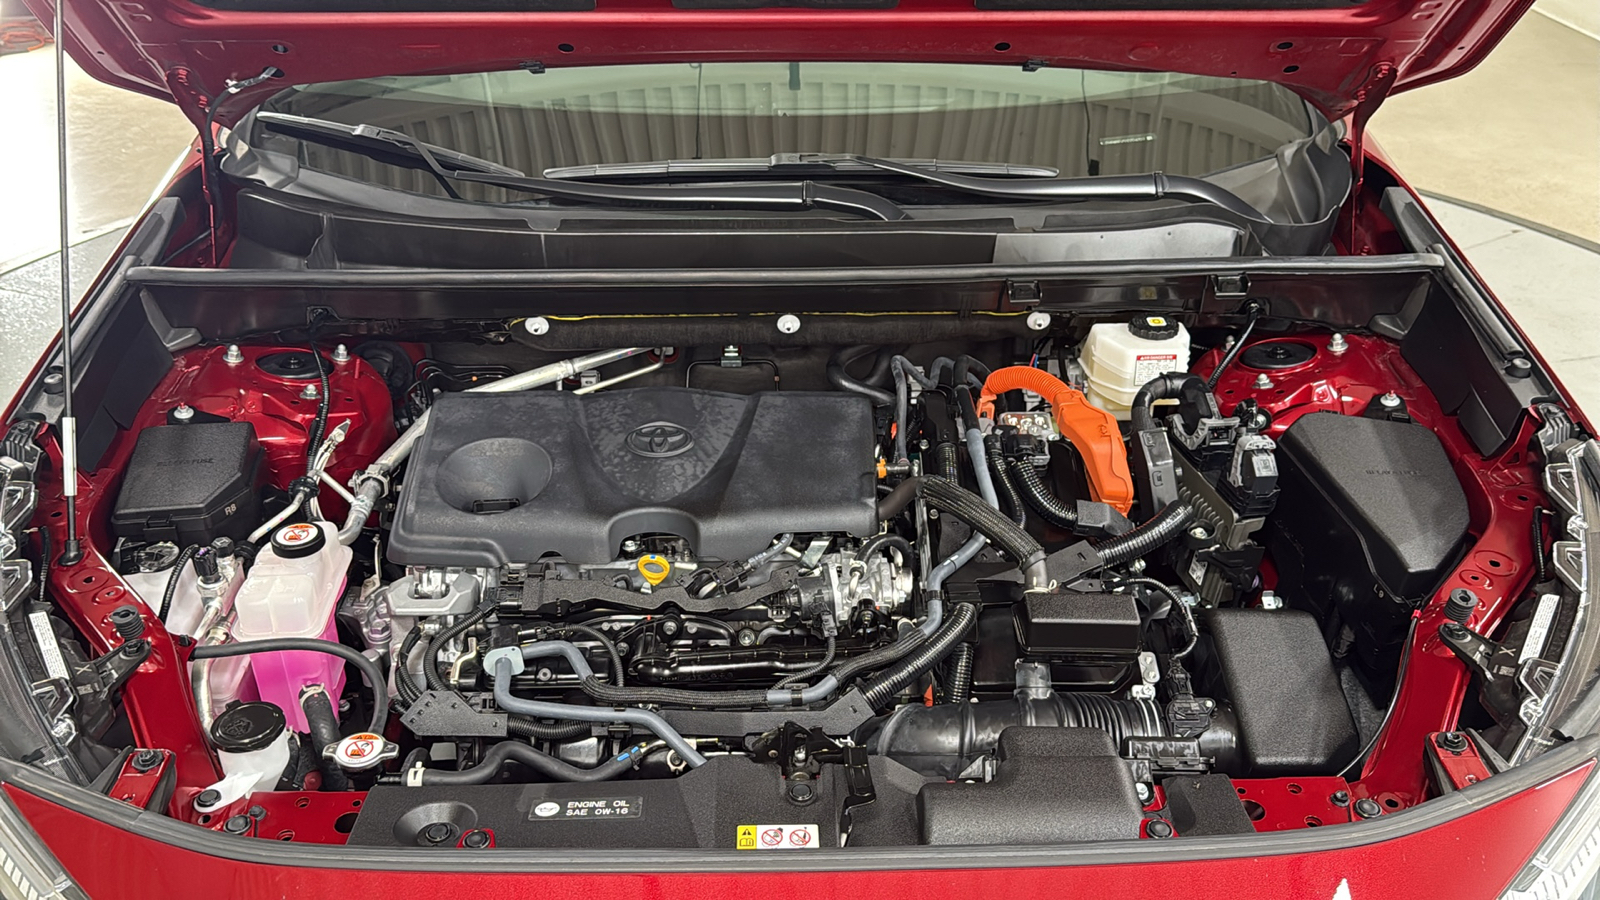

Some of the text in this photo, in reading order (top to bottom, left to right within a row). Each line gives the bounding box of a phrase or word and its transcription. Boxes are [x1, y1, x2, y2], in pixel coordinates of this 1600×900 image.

[224, 503, 237, 516] R8
[567, 800, 607, 809] ENGINE
[565, 808, 588, 816] SAE
